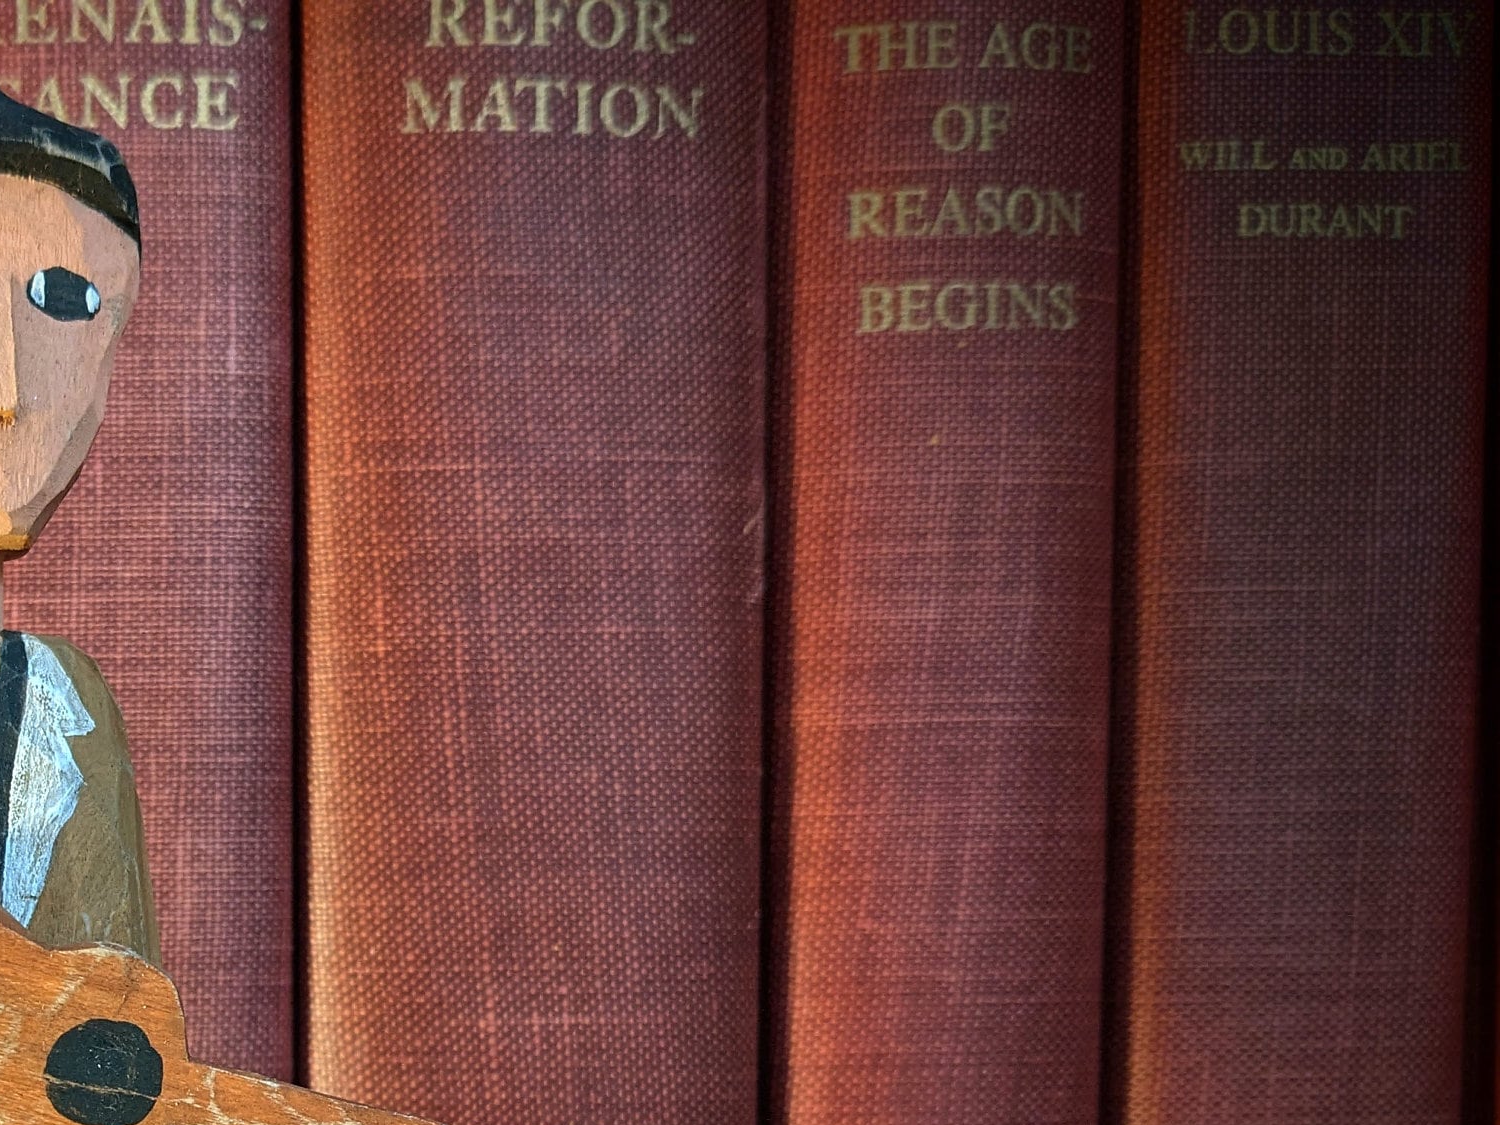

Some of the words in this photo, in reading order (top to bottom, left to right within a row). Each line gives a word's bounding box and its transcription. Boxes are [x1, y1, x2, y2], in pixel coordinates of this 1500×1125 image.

[425, 0, 698, 54] REFOR-
[834, 21, 960, 74] THE
[978, 22, 1092, 74] AGE
[1184, 8, 1356, 57] LOUIS
[1376, 10, 1476, 57] XIV
[401, 74, 703, 139] MATION
[931, 103, 1011, 153] OF
[1179, 140, 1279, 171] WILL
[1290, 146, 1349, 171] AND
[1360, 140, 1469, 172] ARIEL
[847, 185, 1084, 239] REASON
[1237, 203, 1416, 240] DURANT
[855, 281, 1079, 334] BEGINS
